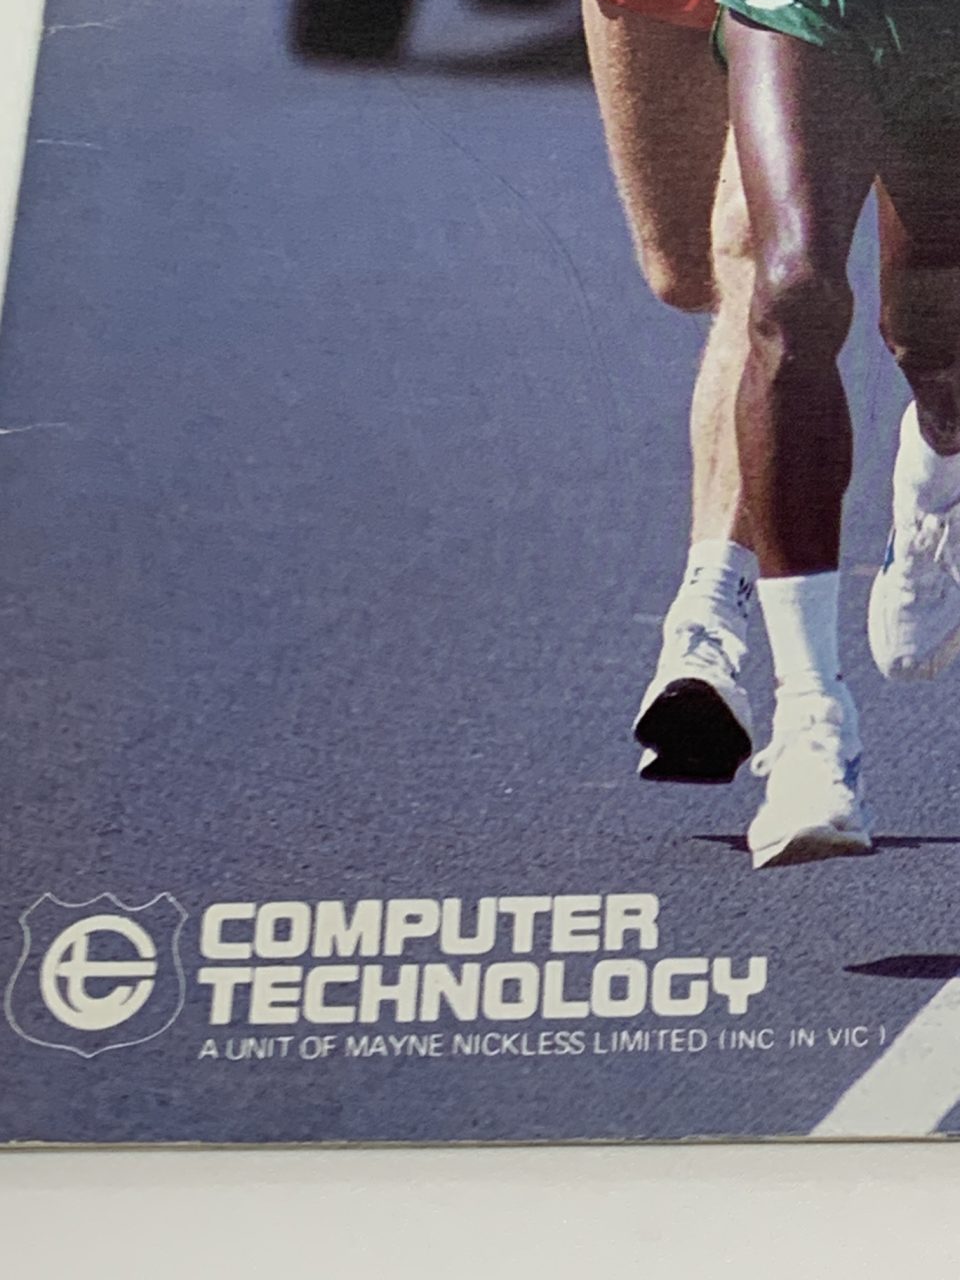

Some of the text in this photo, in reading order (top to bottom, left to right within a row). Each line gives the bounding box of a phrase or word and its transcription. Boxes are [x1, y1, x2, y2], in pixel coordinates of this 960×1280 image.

[201, 893, 660, 960] COMPUTER
[197, 957, 767, 1025] TECHNOLOGY
[199, 1037, 219, 1060] A
[225, 1036, 295, 1060] UNIT
[300, 1034, 337, 1060] OF
[345, 1033, 445, 1058] MAYNE
[452, 1030, 586, 1057] NICKLESS
[593, 1028, 708, 1055] LIMITED
[719, 1027, 775, 1051] (INC
[789, 1028, 816, 1048] IN
